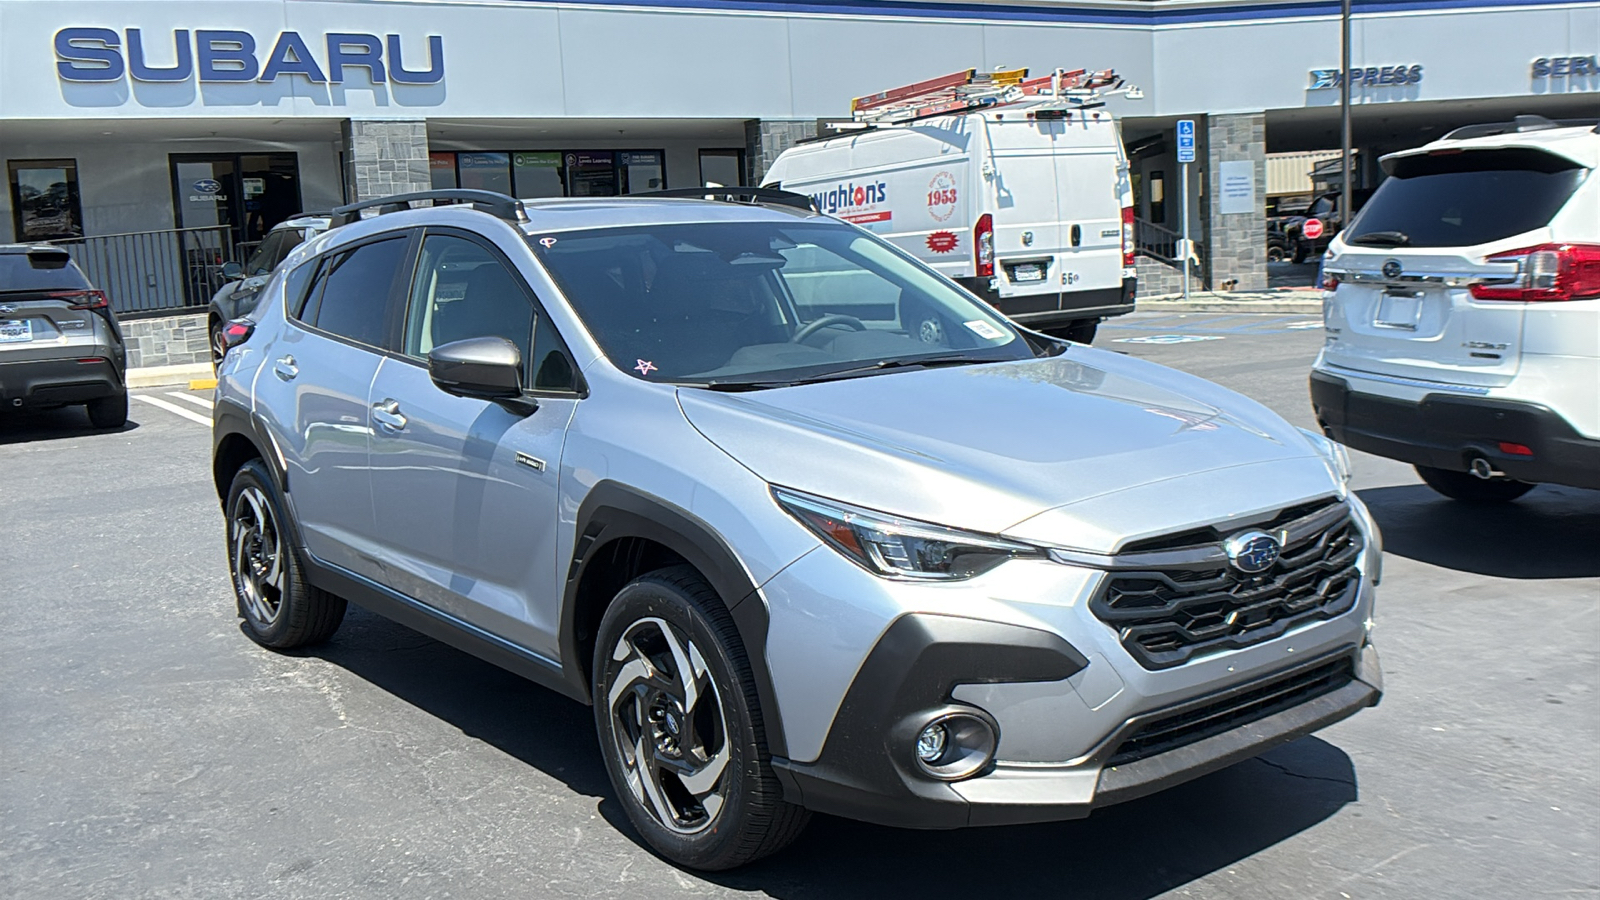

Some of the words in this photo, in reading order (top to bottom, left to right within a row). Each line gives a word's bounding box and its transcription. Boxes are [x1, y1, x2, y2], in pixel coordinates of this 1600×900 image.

[54, 27, 445, 84] SUBARU
[189, 194, 228, 202] SUBARU
[927, 188, 957, 207] 1953
[1061, 272, 1073, 285] 66
